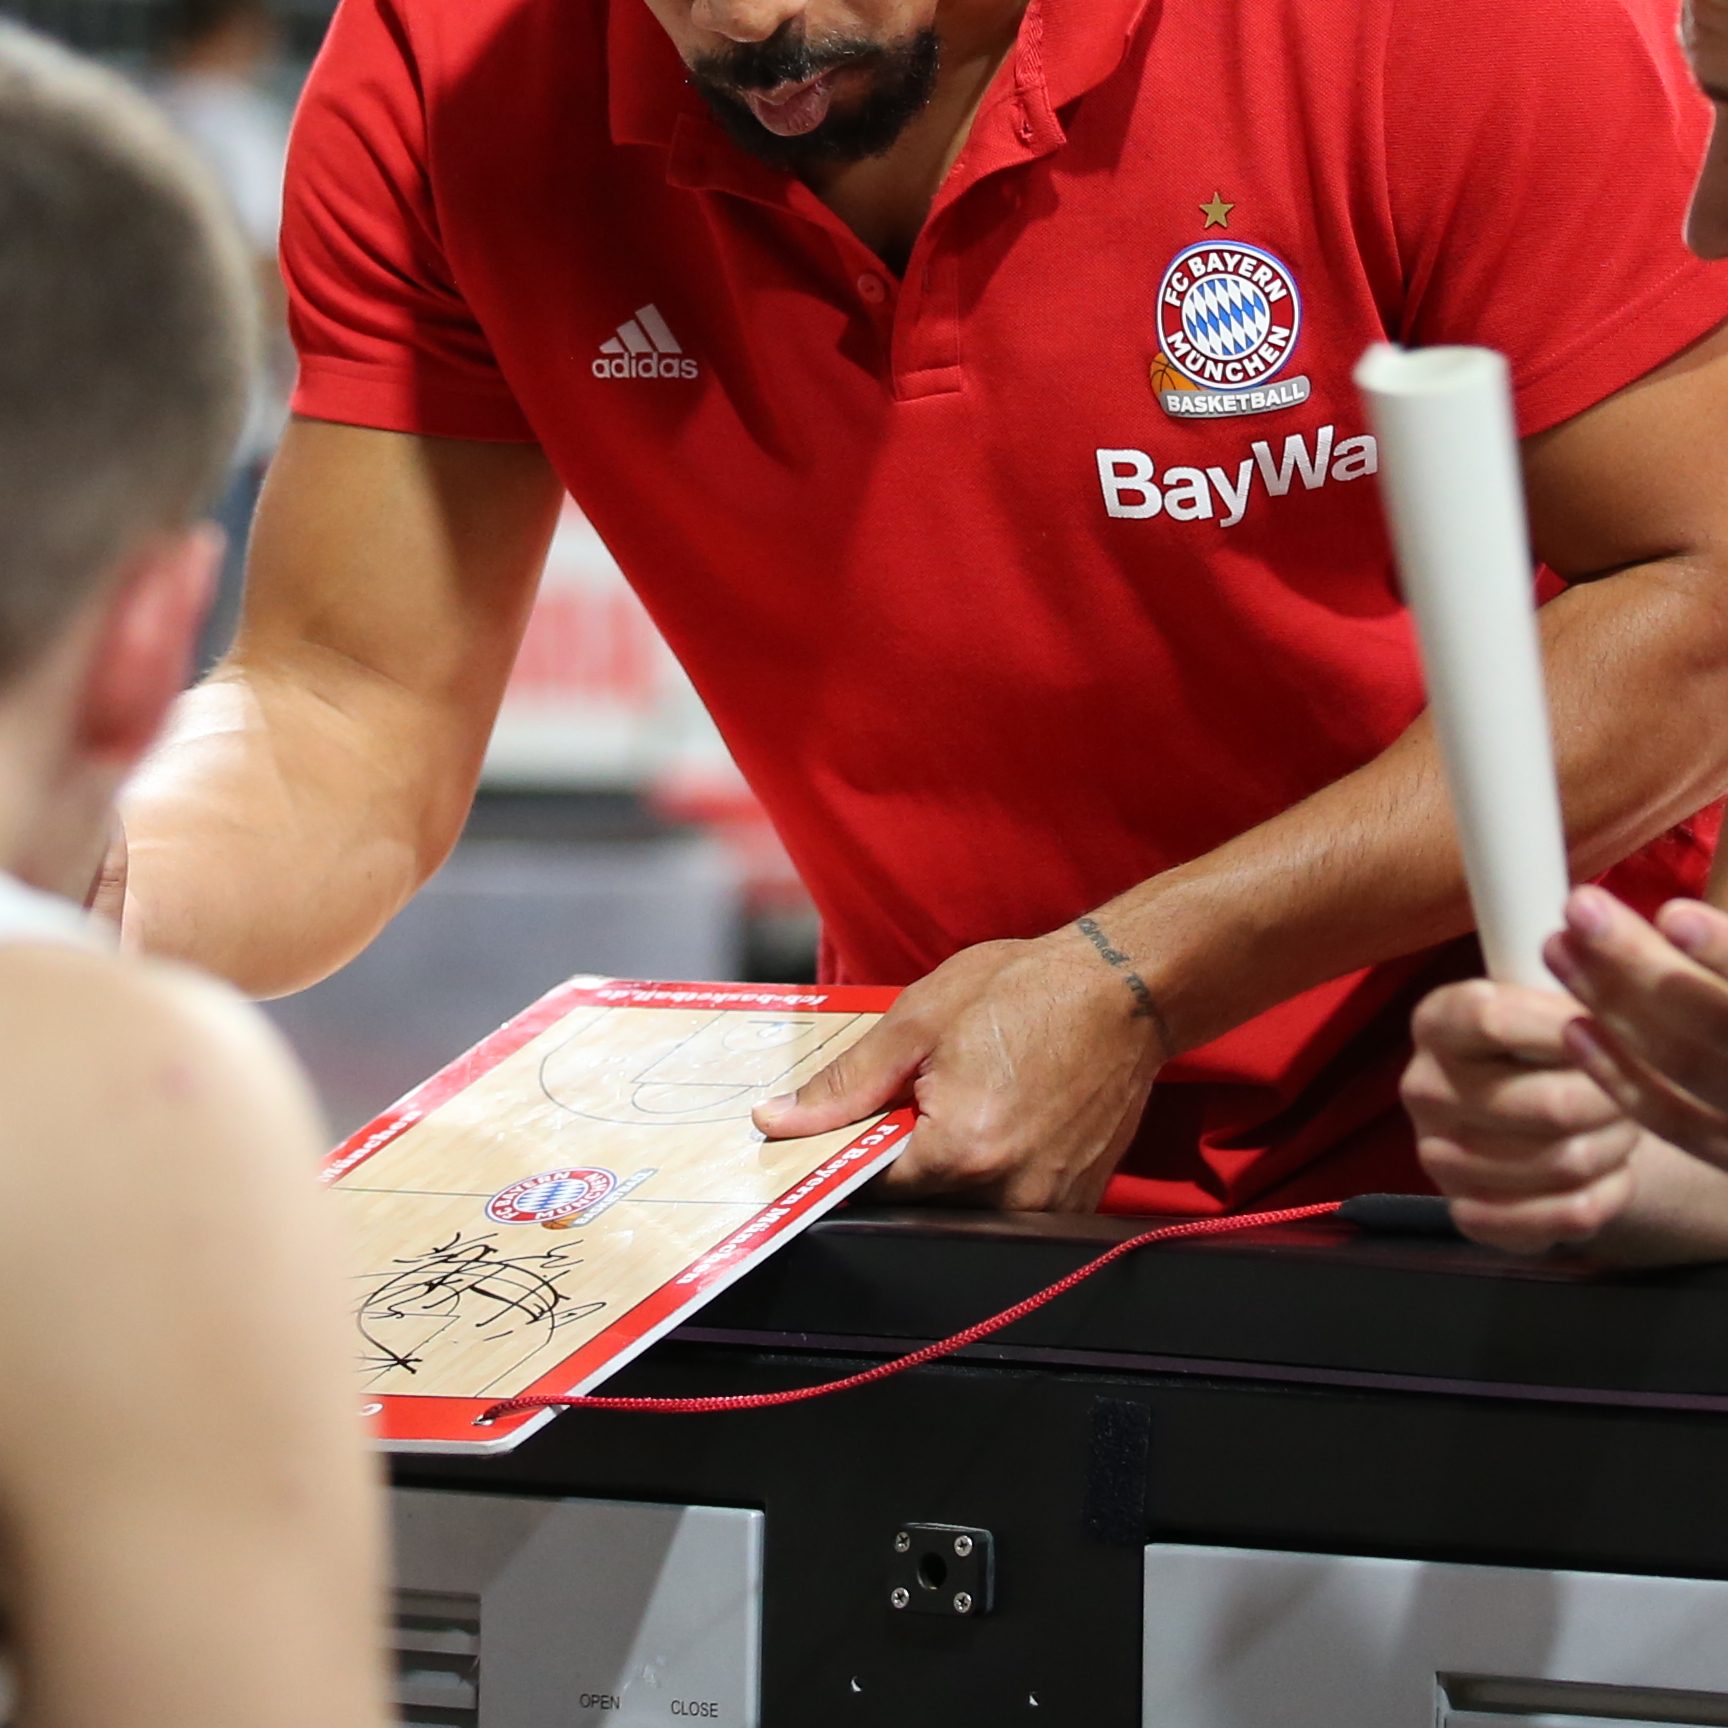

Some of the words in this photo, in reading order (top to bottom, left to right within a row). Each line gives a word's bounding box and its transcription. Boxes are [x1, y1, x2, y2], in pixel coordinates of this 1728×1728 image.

[1165, 272, 1189, 308] FC
[1188, 252, 1287, 303] BAYERN
[591, 351, 699, 379] adidas
[1166, 325, 1291, 382] MÜNCHEN
[1165, 382, 1306, 414] BASKETBALL
[1095, 424, 1378, 527] BayWa
[596, 988, 829, 1007] fcb-basketball.de
[861, 1123, 900, 1147] FC
[494, 1172, 572, 1209] BAYERN
[779, 1147, 870, 1206] Bayern
[675, 1206, 791, 1286] München
[579, 1693, 621, 1710] OPEN
[670, 1699, 719, 1718] CLOSE
